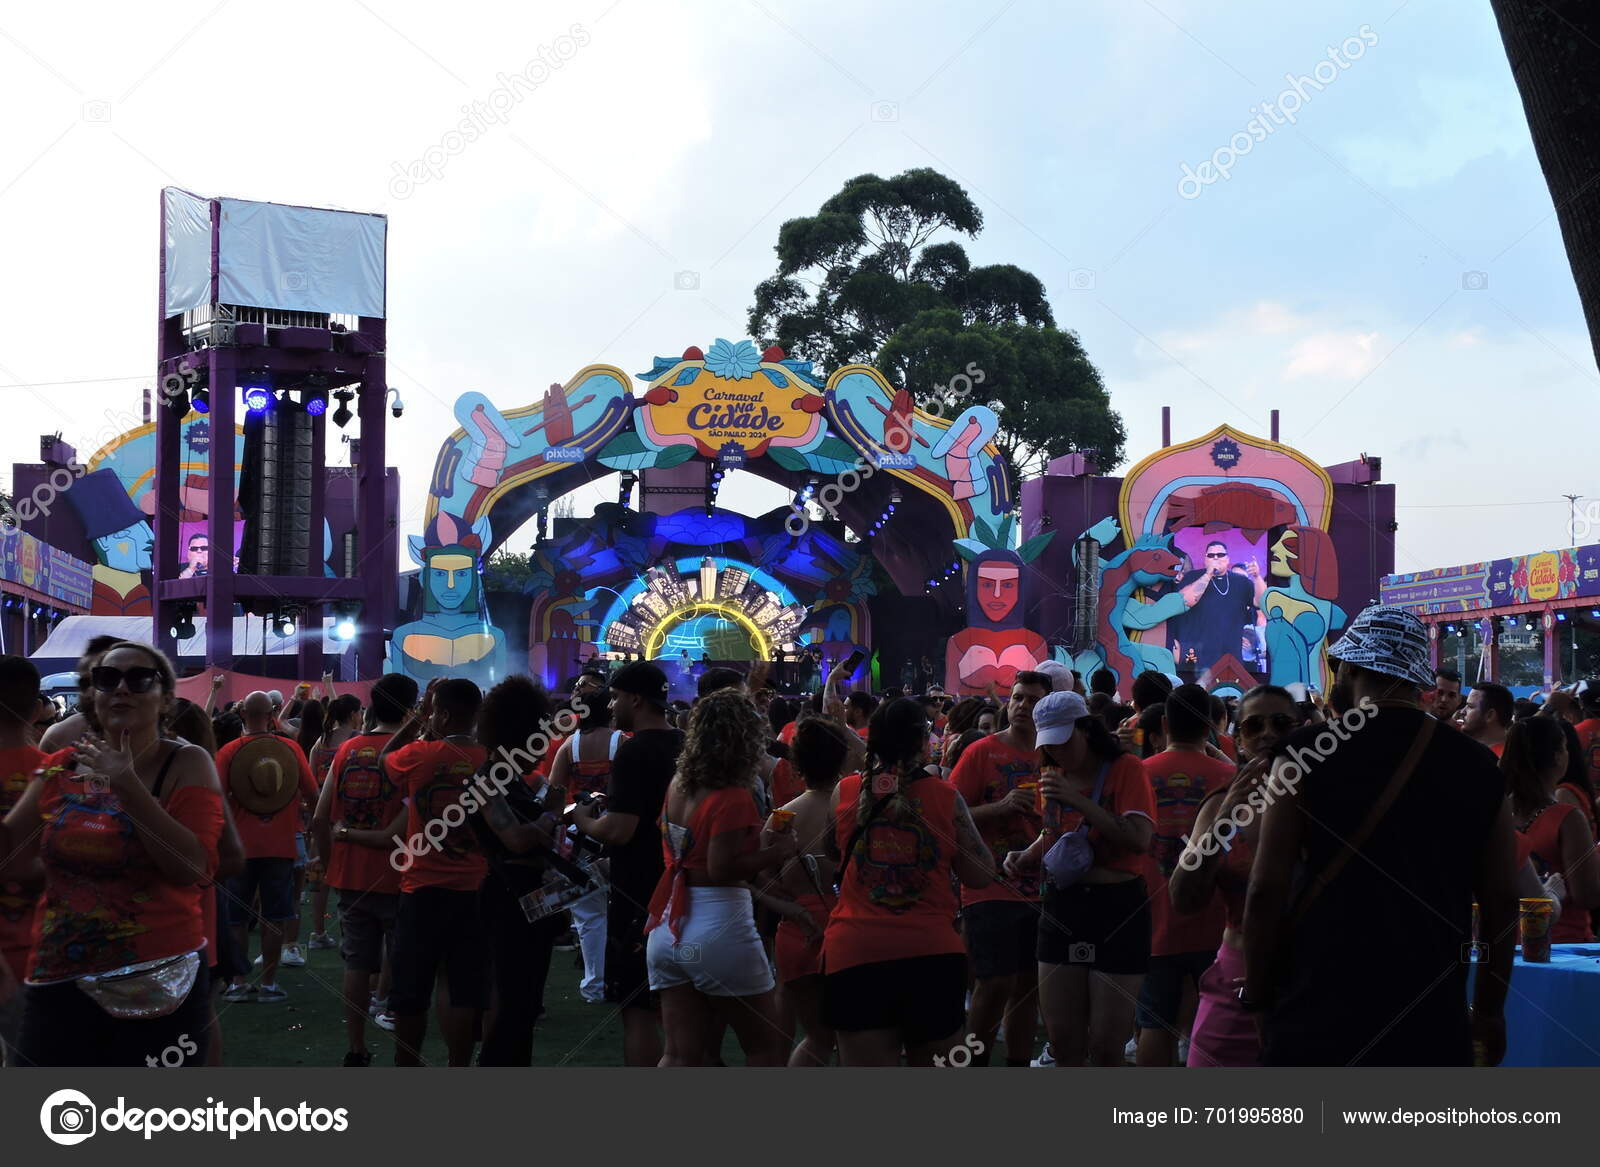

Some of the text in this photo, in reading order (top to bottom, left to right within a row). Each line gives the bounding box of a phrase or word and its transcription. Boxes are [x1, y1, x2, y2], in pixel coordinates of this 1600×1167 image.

[703, 388, 764, 402] Carnaval
[687, 403, 784, 431] Cidade
[708, 429, 723, 438] SÃO
